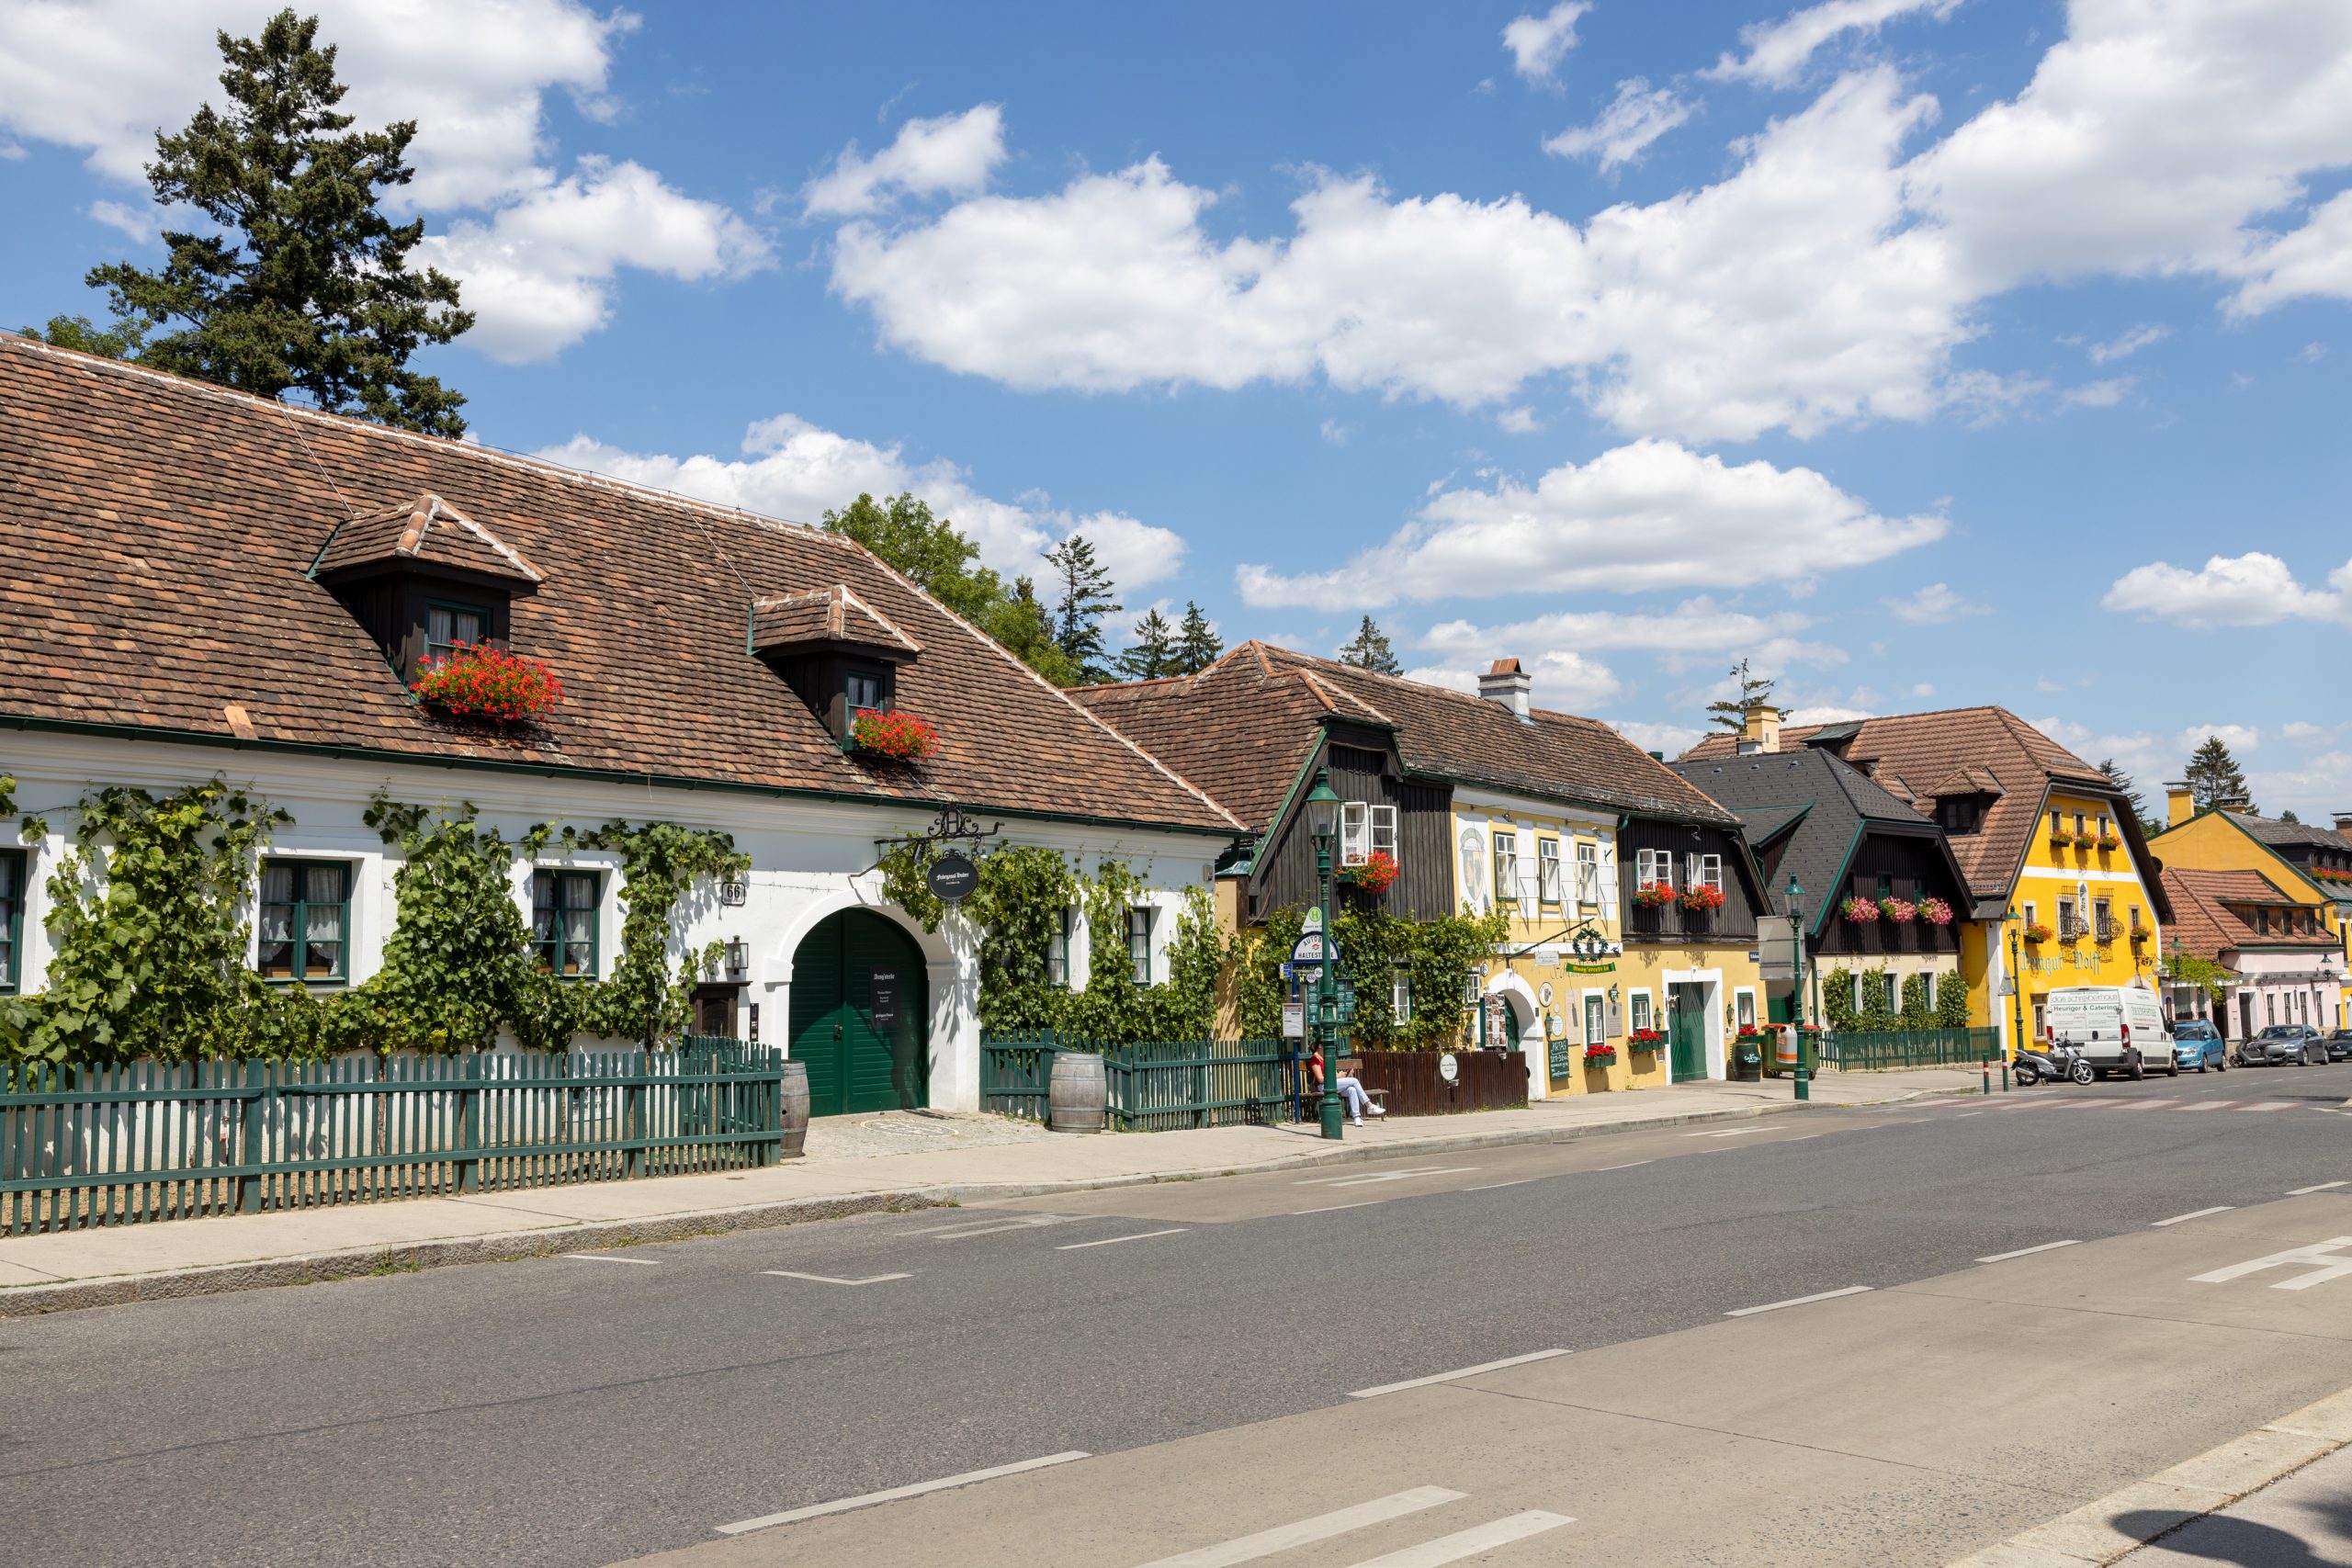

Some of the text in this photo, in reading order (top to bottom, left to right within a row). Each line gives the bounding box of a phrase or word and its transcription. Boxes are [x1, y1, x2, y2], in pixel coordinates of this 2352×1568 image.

[727, 885, 741, 898] 66
[1311, 910, 1318, 919] H
[2018, 949, 2102, 976] Weingut Wolff
